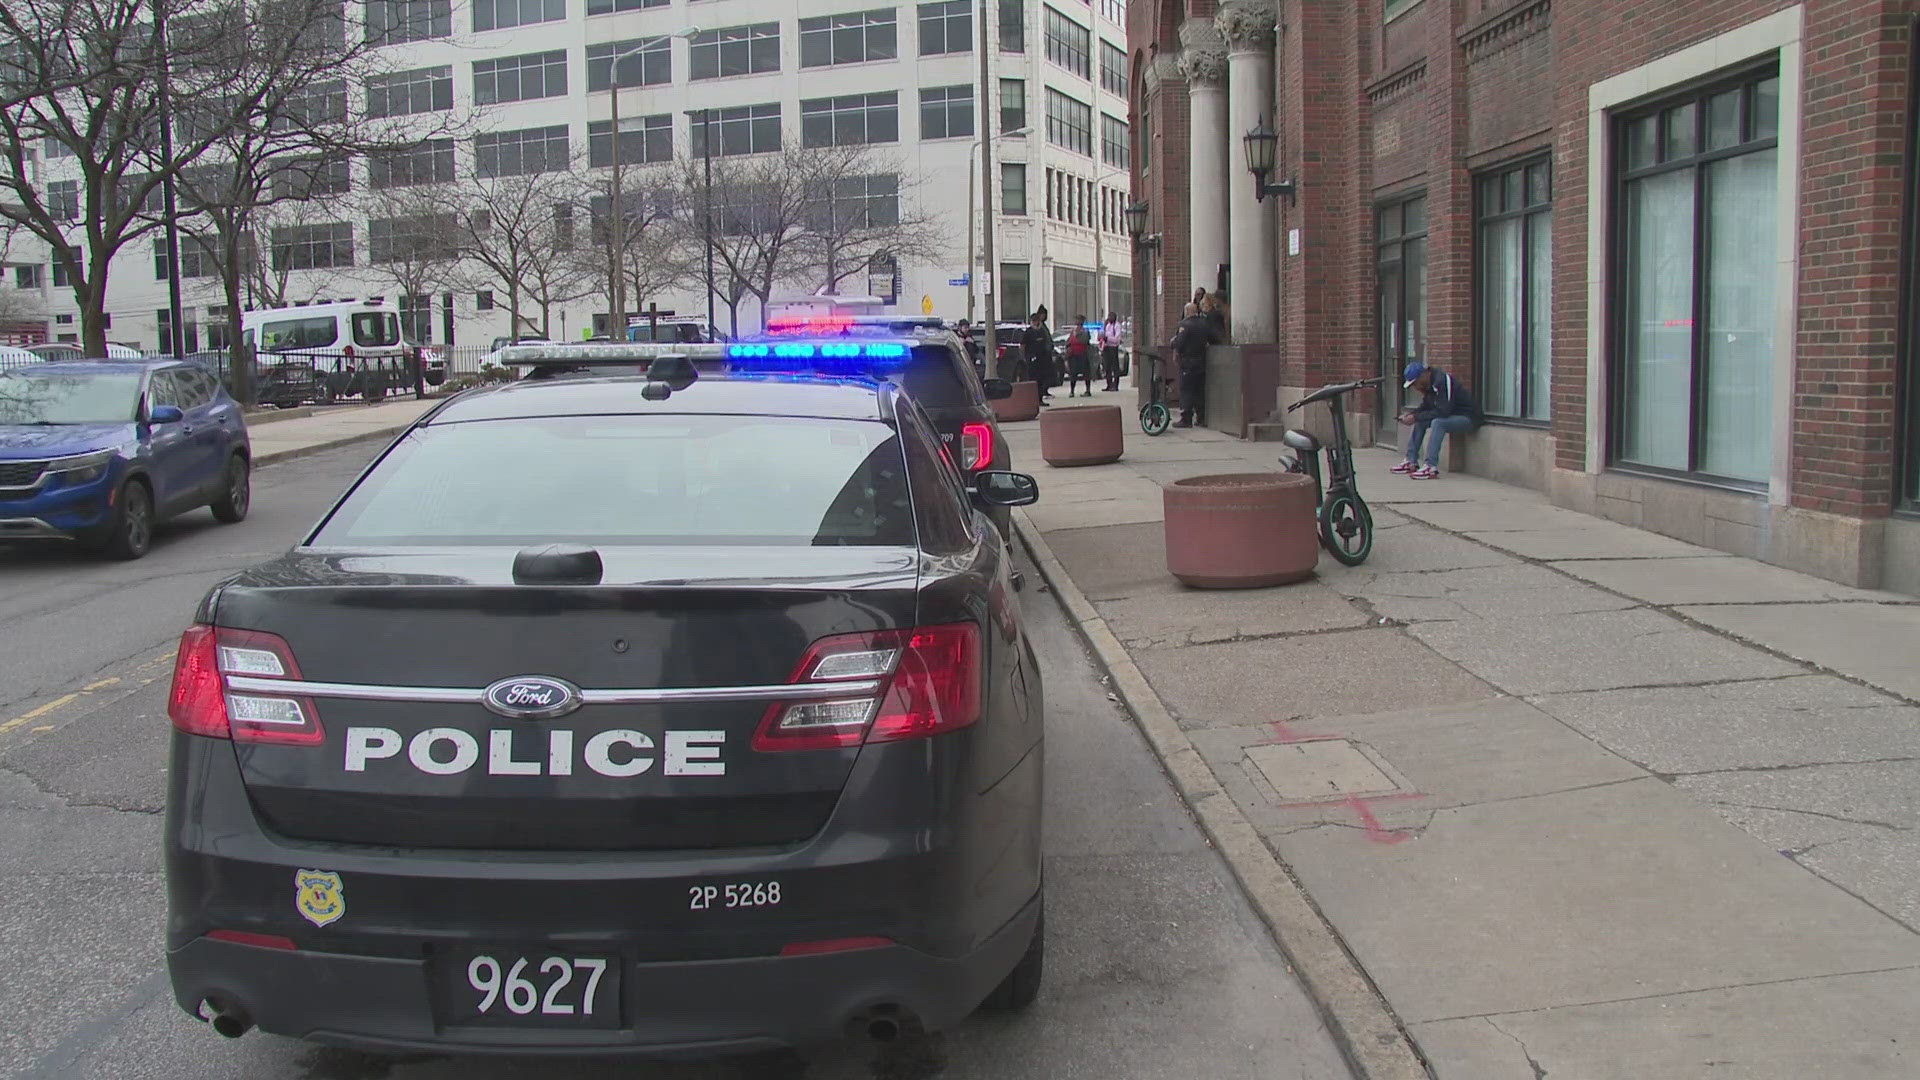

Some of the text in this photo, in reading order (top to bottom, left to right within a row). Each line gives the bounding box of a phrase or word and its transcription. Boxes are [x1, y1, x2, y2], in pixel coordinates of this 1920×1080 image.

[506, 684, 552, 705] Ford
[344, 727, 726, 777] POLICE
[689, 881, 781, 910] 2P 5268
[467, 955, 606, 1014] 9627
